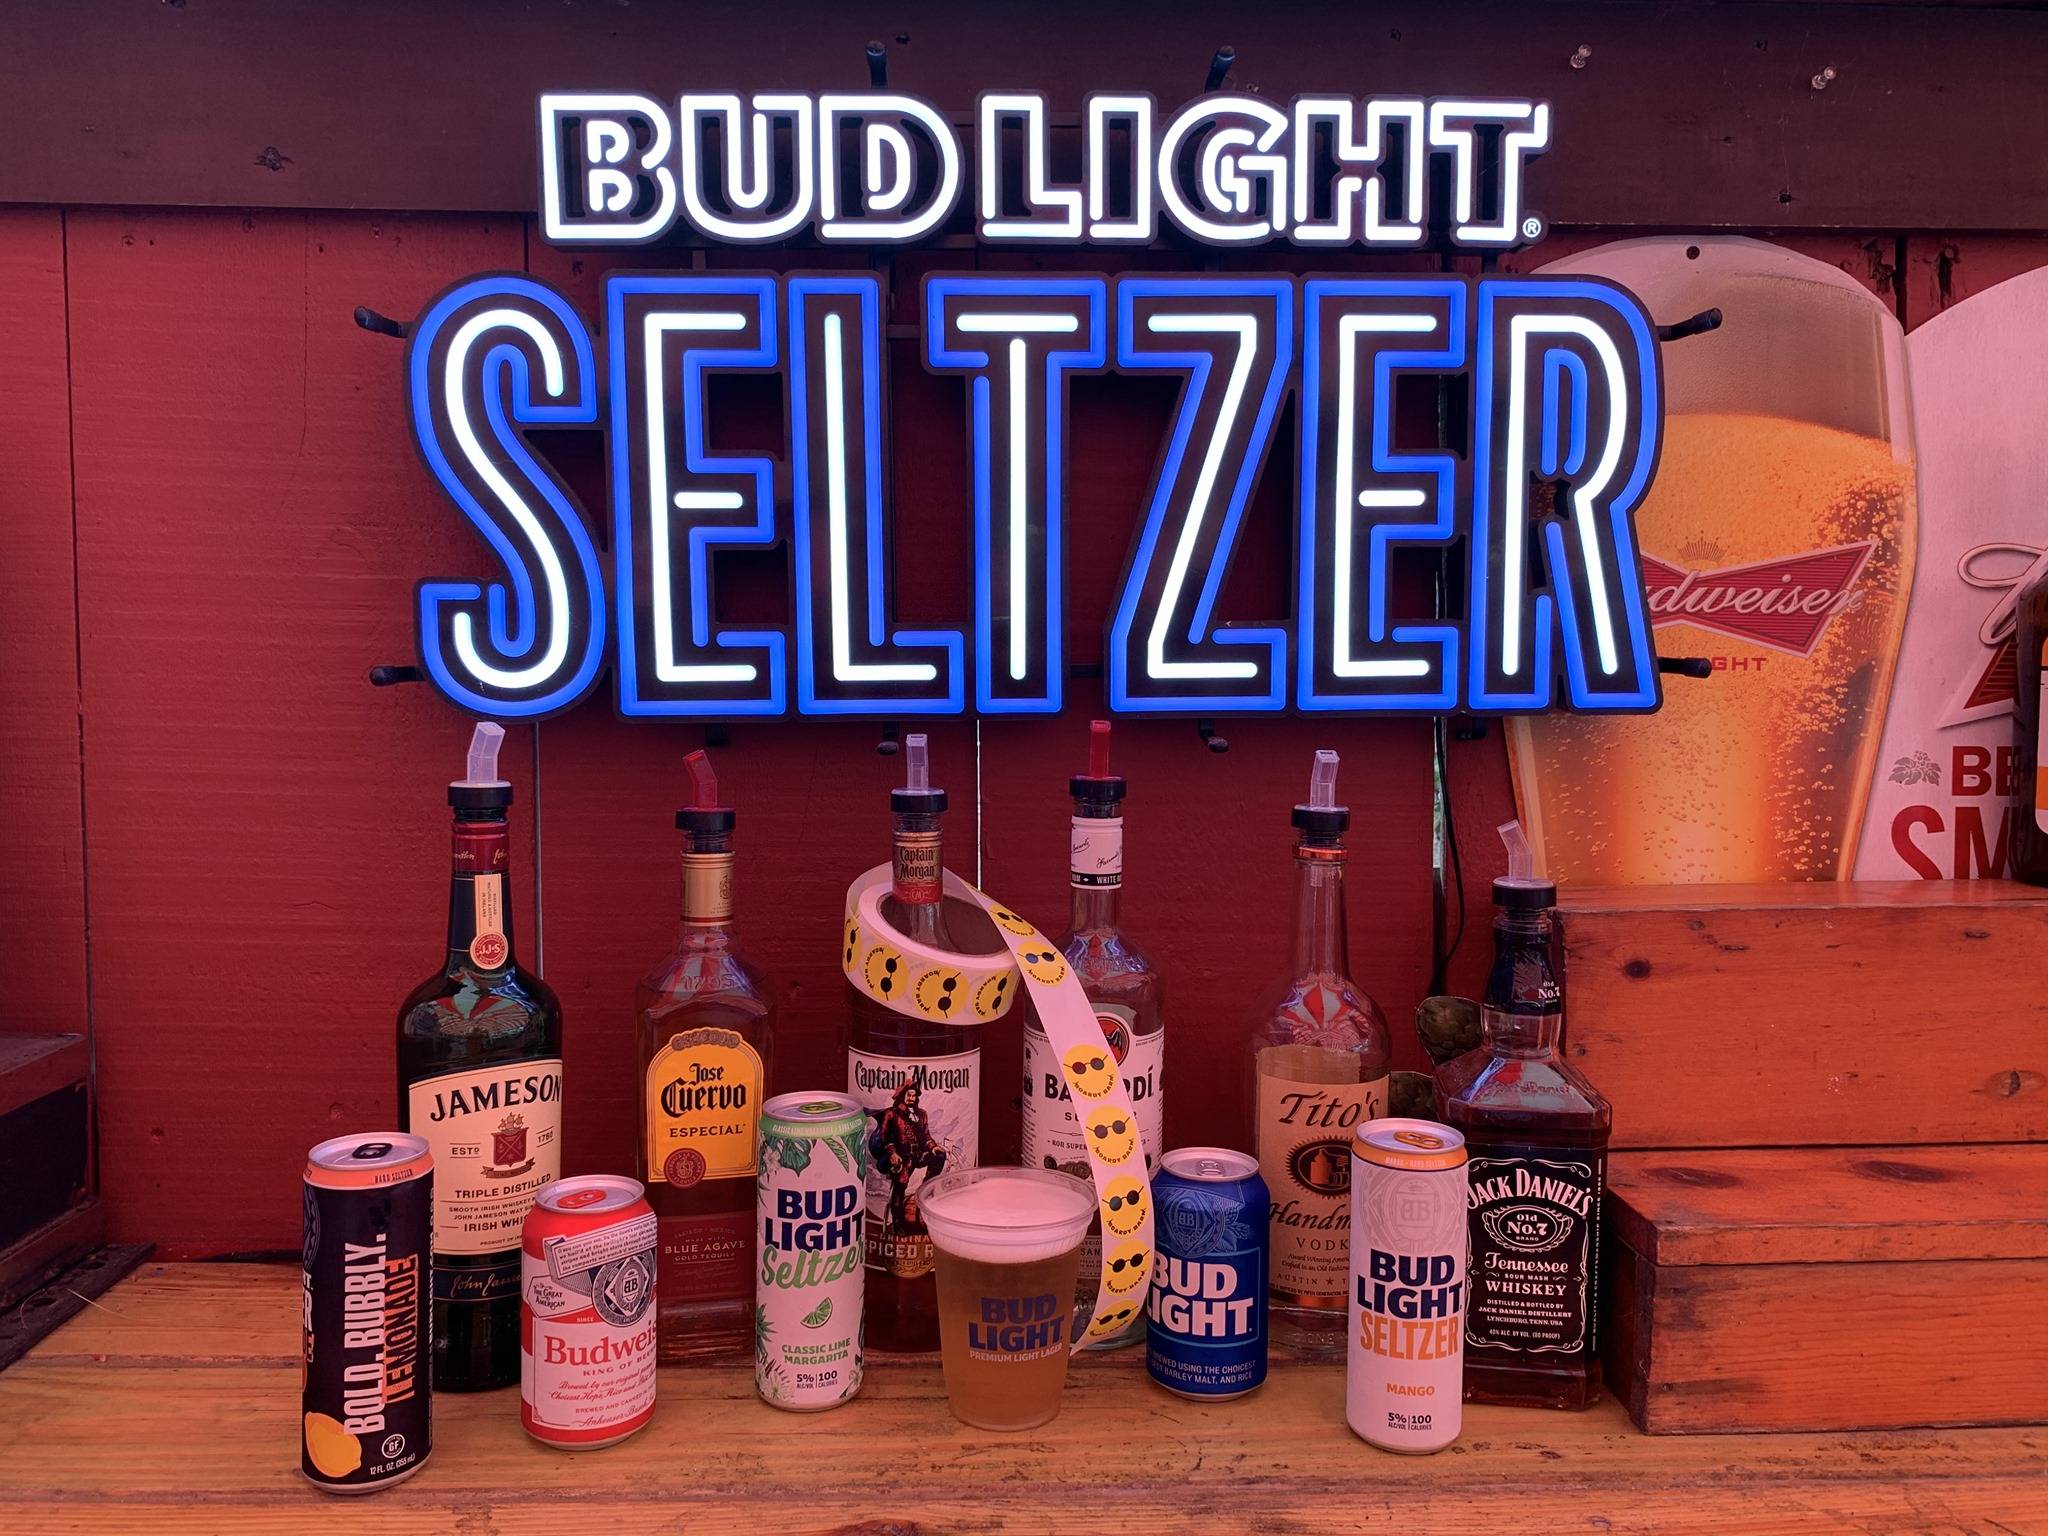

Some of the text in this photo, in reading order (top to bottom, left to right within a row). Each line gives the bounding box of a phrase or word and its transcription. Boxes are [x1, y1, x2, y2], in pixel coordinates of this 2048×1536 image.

[539, 93, 1549, 242] BUD LIGHT
[408, 274, 1662, 716] SELTZER
[1645, 571, 1863, 617] dweiser
[1710, 656, 1767, 672] GHT
[900, 846, 936, 863] Captain
[899, 863, 936, 881] Morgan
[689, 1062, 724, 1087] Jose
[855, 1060, 970, 1094] Captain Morgan
[1045, 1064, 1154, 1102] BADÍ
[1072, 1073, 1116, 1098] BOARDY BARN
[430, 1074, 562, 1122] JAMESON
[661, 1077, 747, 1118] Cuervo
[1278, 1090, 1379, 1128] Tito's
[537, 1131, 554, 1144] 1780
[669, 1124, 744, 1138] ESPECIAL
[1066, 1140, 1088, 1151] SUPER
[1093, 1137, 1136, 1164] BOARDY BARN
[455, 1173, 551, 1199] TRIPLE DISTILLED
[1468, 1168, 1594, 1217] JACK DANIEL'S
[501, 1198, 530, 1209] WHISKEY
[777, 1185, 857, 1220] BUD
[474, 1211, 508, 1220] JAMESON
[509, 1207, 524, 1215] WAY
[1106, 1207, 1147, 1236] BOARDY BARN
[1269, 1200, 1351, 1231] Handm
[1516, 1213, 1538, 1222] Old
[464, 1222, 497, 1232] IRISH
[765, 1210, 865, 1252] LIGHT
[665, 1240, 746, 1254] BLUE AGAVE
[879, 1233, 931, 1243] ORIGINA
[1296, 1237, 1349, 1251] VODK
[674, 1252, 736, 1262] GOLD TEQUILA
[762, 1236, 865, 1289] Seltzer
[1288, 1253, 1332, 1264] Award Winning
[1484, 1252, 1569, 1274] Tennessee
[1150, 1250, 1238, 1299] BUD
[1316, 1264, 1328, 1272] Old
[1370, 1248, 1455, 1287] BUD
[1277, 1273, 1318, 1285] AUSTIN
[1485, 1280, 1567, 1296] WHISKEY
[543, 1288, 563, 1298] GREAT
[1357, 1274, 1463, 1319] LIGHT
[980, 1293, 1056, 1325] BUD
[1478, 1306, 1572, 1318] JACK DANIEL DISTILLERY
[1487, 1299, 1520, 1307] DISTILLED
[1526, 1301, 1555, 1309] BOTTLED
[344, 1232, 386, 1435] BOLD. BUBBLY.
[383, 1253, 419, 1404] LEMONADE
[968, 1315, 1065, 1352] LIGHT
[1360, 1310, 1459, 1361] SELTZER
[544, 1320, 656, 1366] Budwei
[781, 1337, 851, 1355] CLASSIC LIME
[784, 1349, 849, 1366] MARGARITA
[969, 1342, 1063, 1363] PREMIUM LIGHT LAGER
[583, 1366, 614, 1377] KING
[620, 1361, 633, 1370] OF
[1178, 1360, 1257, 1374] USING THE CHOICEST
[796, 1370, 838, 1383] 5% 100
[1164, 1368, 1253, 1385] BARLEY MALT, AND RICE
[1386, 1383, 1435, 1396] MANGO
[576, 1405, 604, 1414] BREWED
[606, 1402, 619, 1410] AND
[1387, 1412, 1432, 1424] 5% 100
[388, 1441, 400, 1452] GF
[370, 1467, 377, 1475] 12
